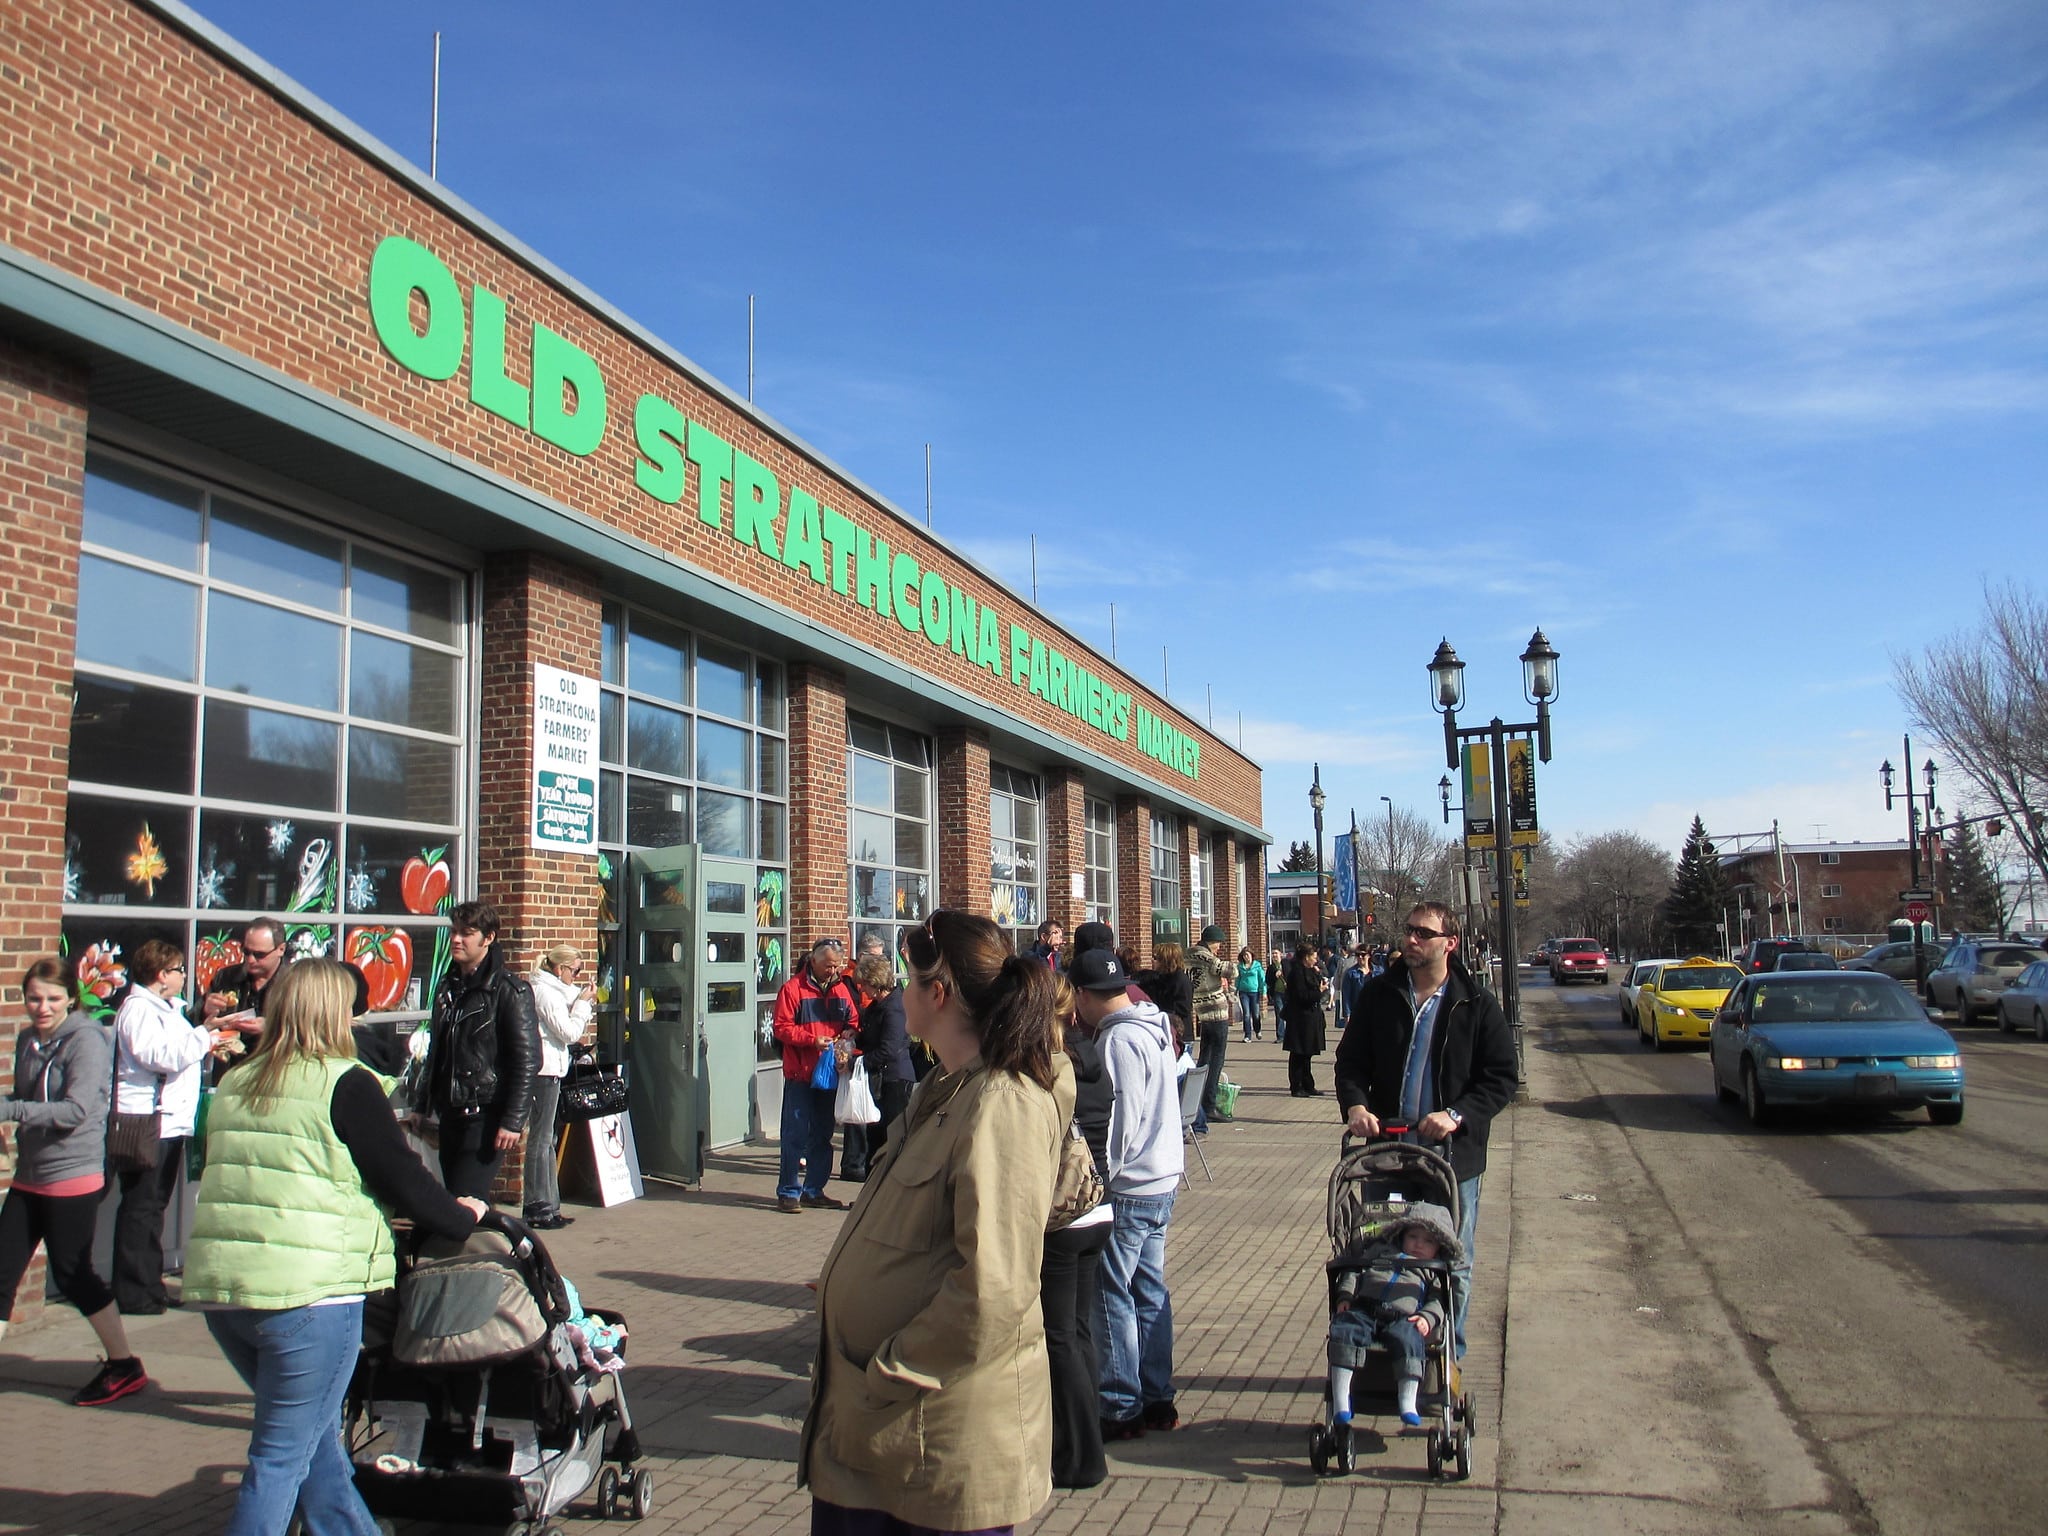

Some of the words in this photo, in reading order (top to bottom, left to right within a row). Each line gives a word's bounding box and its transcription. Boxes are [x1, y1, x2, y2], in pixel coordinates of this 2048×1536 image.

[369, 236, 607, 457] OLD
[634, 394, 1002, 676] STRATHCONA
[1010, 623, 1132, 742] FARMERS'
[1136, 705, 1200, 781] MARKET
[560, 678, 577, 695] OLD
[539, 694, 596, 722] STRATHCONA
[544, 719, 591, 742] FARMERS'
[548, 743, 588, 764] MARKET
[556, 775, 578, 791] OPEN
[540, 786, 562, 803] YEAR
[564, 789, 592, 807] ROUND
[543, 807, 588, 827] SATURDAYS
[1906, 908, 1928, 917] STOP
